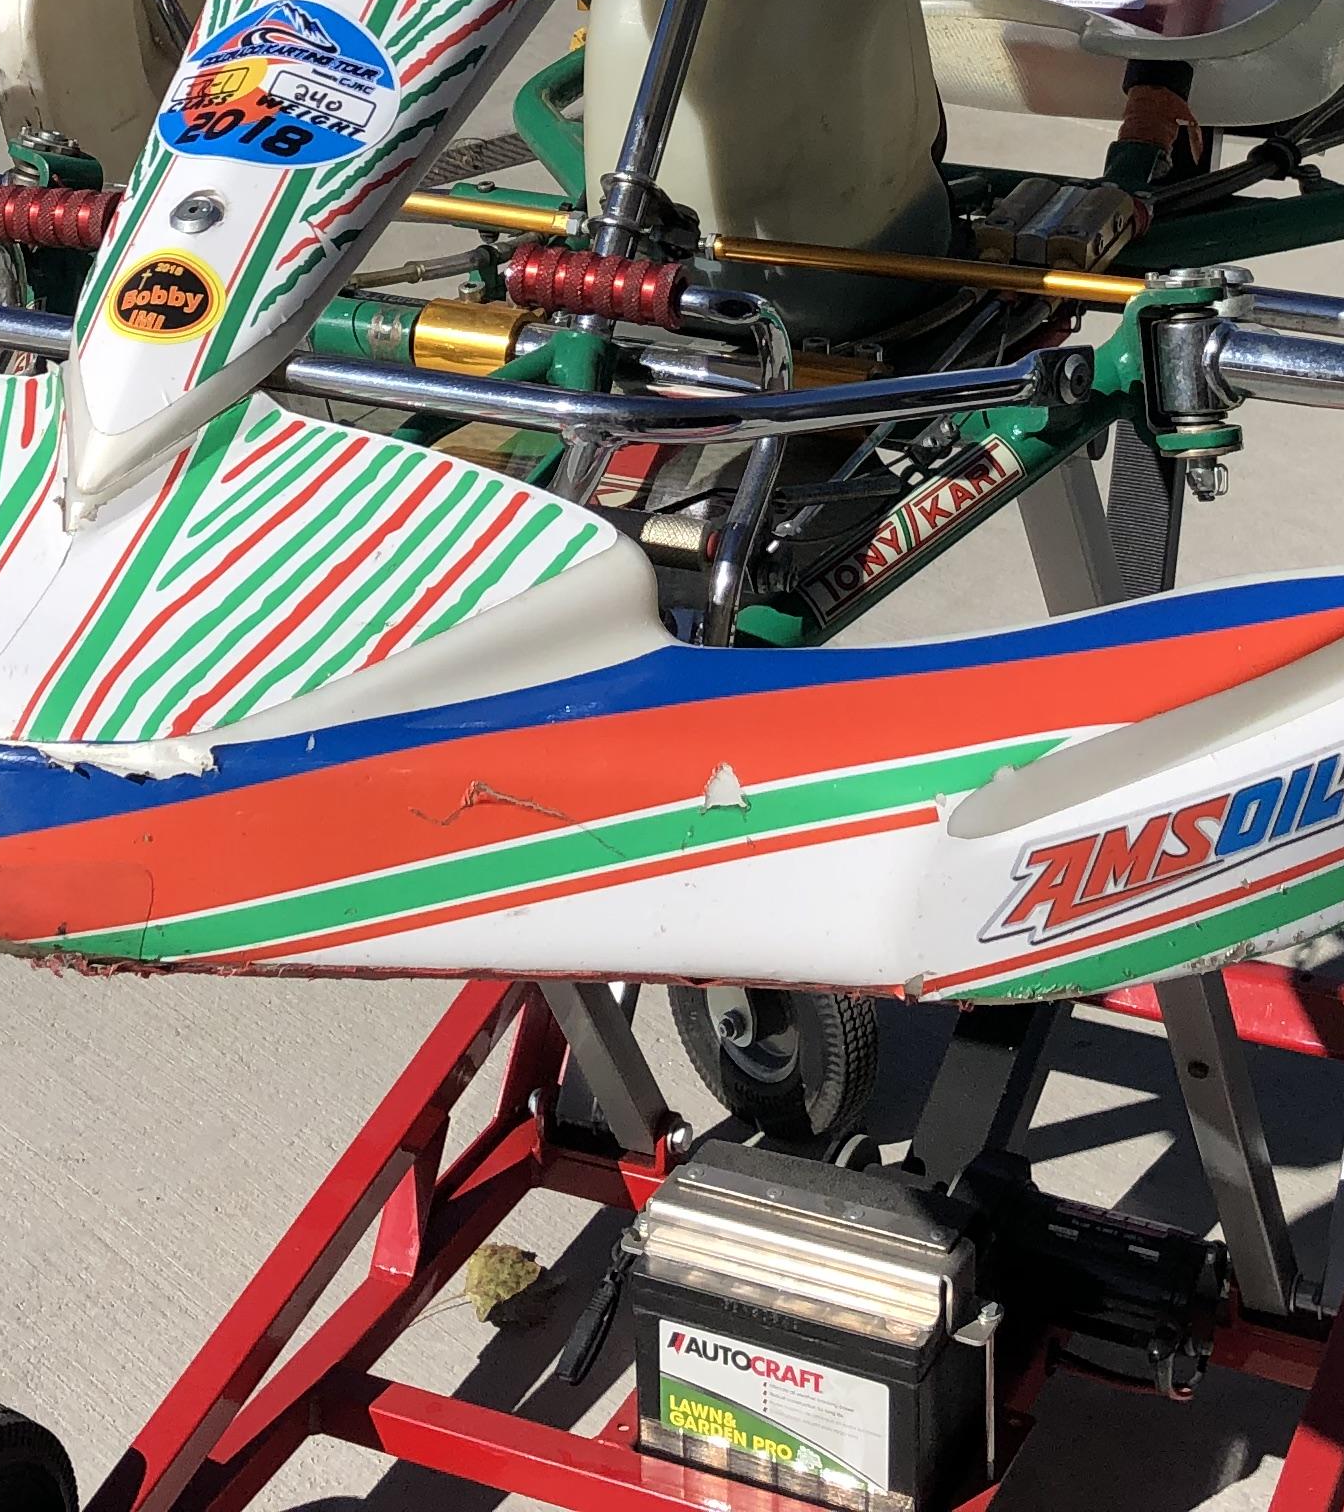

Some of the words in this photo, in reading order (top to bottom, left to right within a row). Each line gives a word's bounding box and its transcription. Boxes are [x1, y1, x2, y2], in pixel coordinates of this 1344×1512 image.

[264, 43, 332, 68] KARTING
[333, 59, 379, 80] TOUR
[167, 93, 234, 114] CLASS
[256, 94, 366, 138] WEIGHT
[294, 84, 343, 112] 240
[174, 108, 314, 158] 2018
[121, 285, 204, 313] Bobby
[917, 442, 1012, 530] KART
[684, 1336, 824, 1393] AUTOCRAFT
[669, 1394, 737, 1428] LAWN&
[669, 1411, 748, 1448] GARDEN
[753, 1435, 793, 1461] PRO
